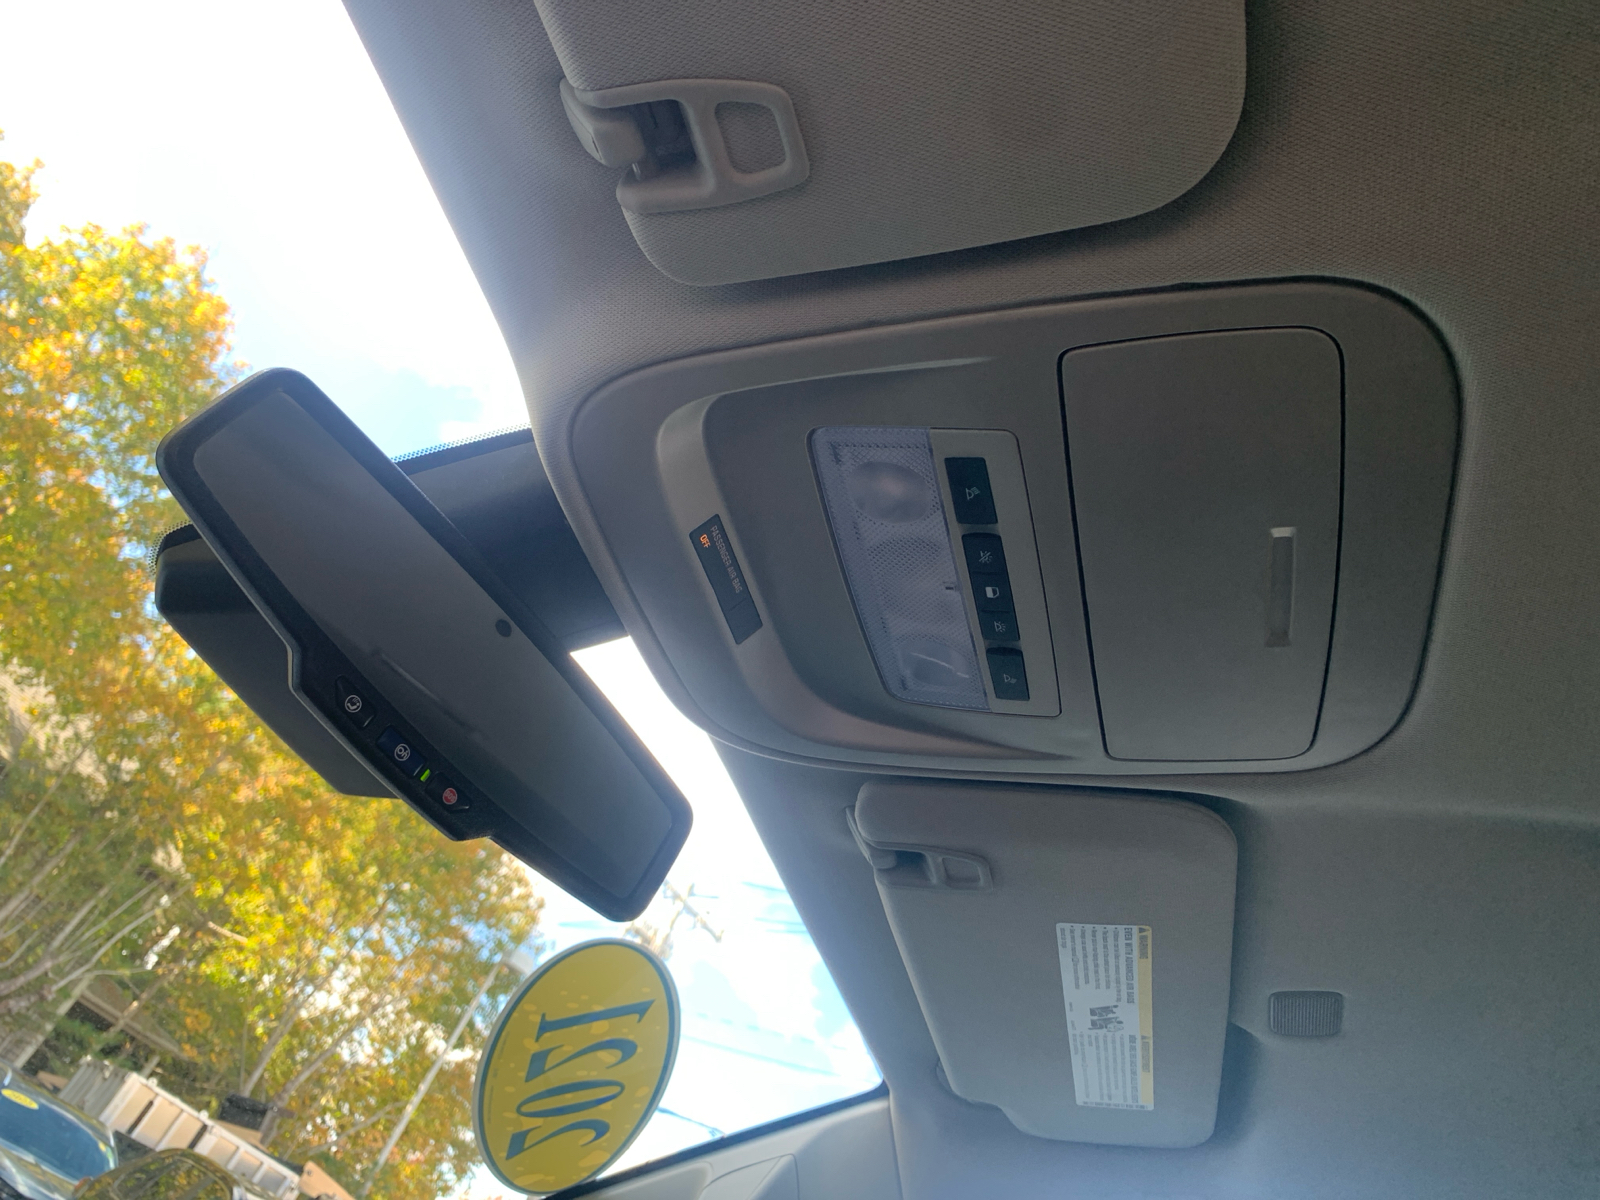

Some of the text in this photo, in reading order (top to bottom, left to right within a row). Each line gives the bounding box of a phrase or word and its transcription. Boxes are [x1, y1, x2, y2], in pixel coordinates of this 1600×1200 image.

[699, 534, 711, 548] OFF
[710, 525, 743, 594] PASSENGER AIR BAG
